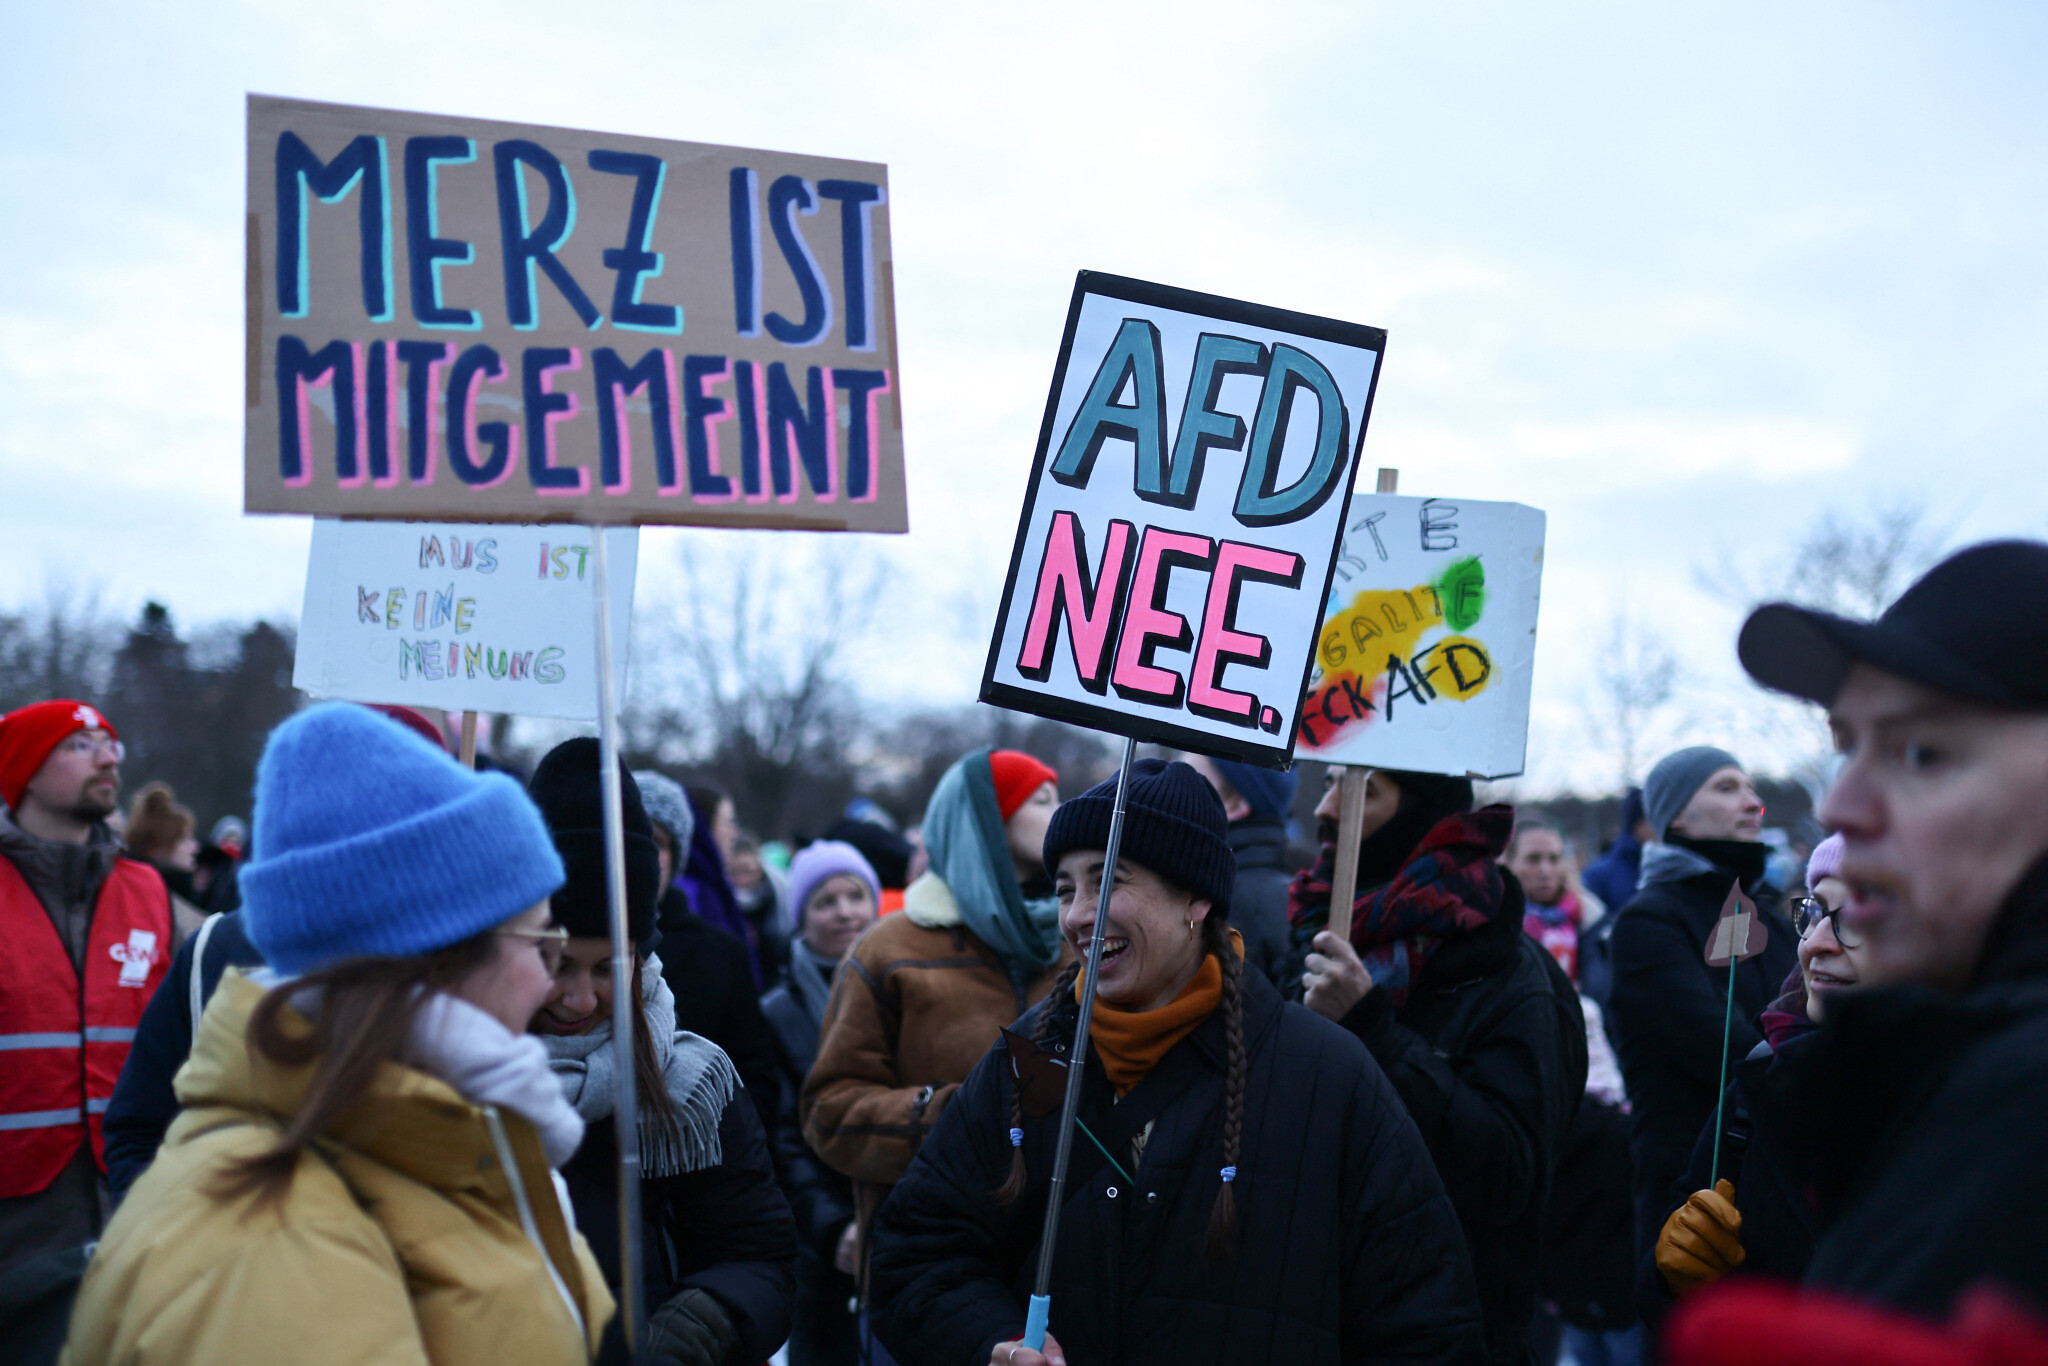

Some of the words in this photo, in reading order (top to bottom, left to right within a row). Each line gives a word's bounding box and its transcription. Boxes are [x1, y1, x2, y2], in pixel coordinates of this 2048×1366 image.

[275, 131, 684, 334] MERZ
[729, 166, 886, 352] IST
[275, 335, 891, 504] MITGEMEINT
[1049, 317, 1350, 528] AFD
[357, 582, 477, 634] KEINE
[419, 534, 498, 574] MUS
[538, 541, 592, 581] IST
[1016, 510, 1306, 735] NEE.
[1310, 553, 1484, 684] GALITÉ
[399, 637, 566, 684] MEINUNG
[1386, 642, 1491, 722] AFD
